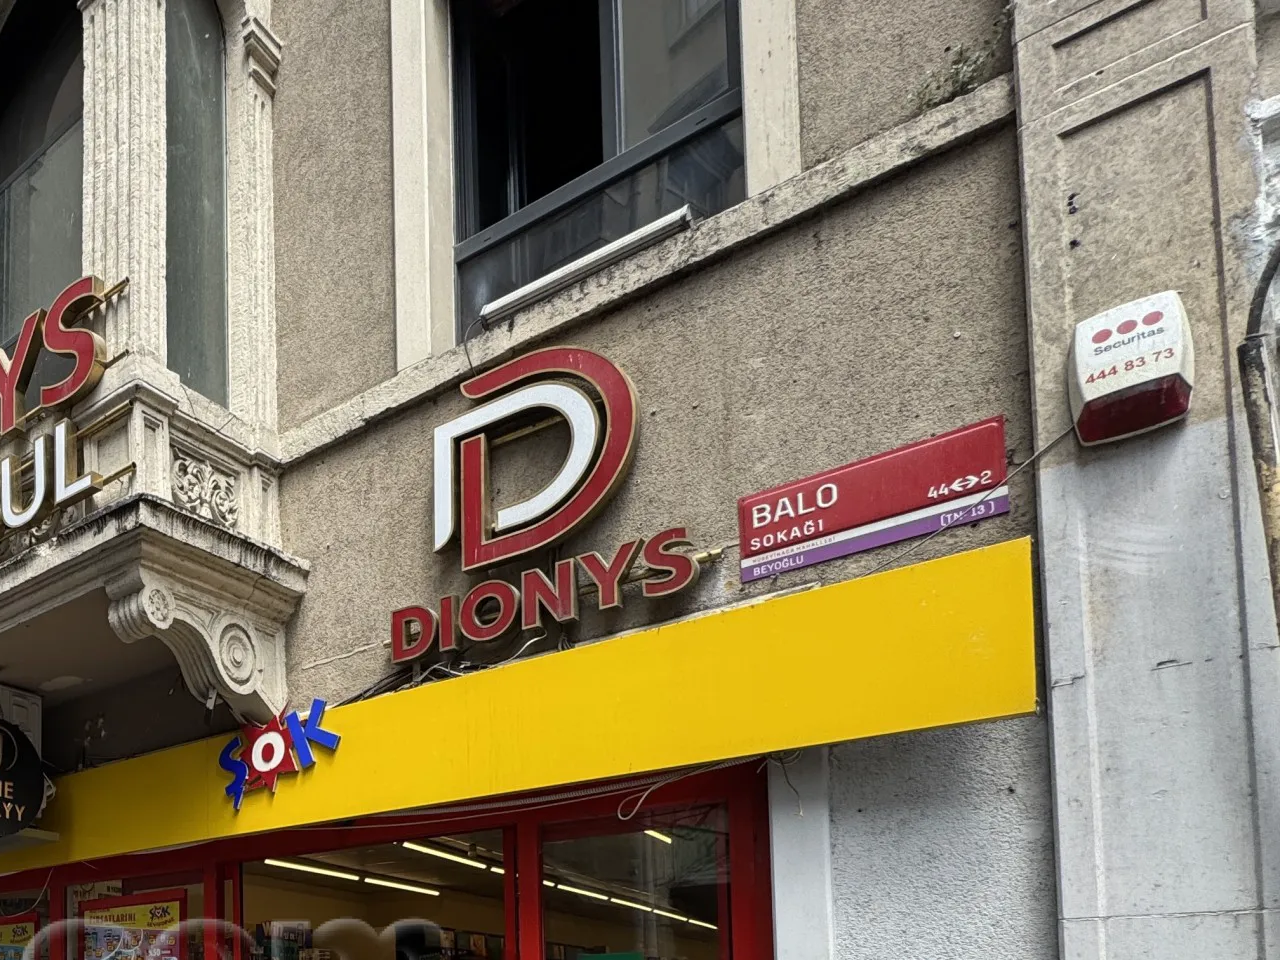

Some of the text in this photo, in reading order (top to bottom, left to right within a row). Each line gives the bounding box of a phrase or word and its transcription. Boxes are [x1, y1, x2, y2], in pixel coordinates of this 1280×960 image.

[1093, 326, 1165, 356] Securitas
[1085, 347, 1175, 385] 444 83 73
[927, 470, 993, 499] 44 2
[751, 482, 839, 529] BALO
[750, 518, 825, 551] SOKAĞI
[753, 554, 804, 577] BEYOĞLU
[390, 526, 700, 664] DIONYS
[218, 696, 342, 812] ŞOK
